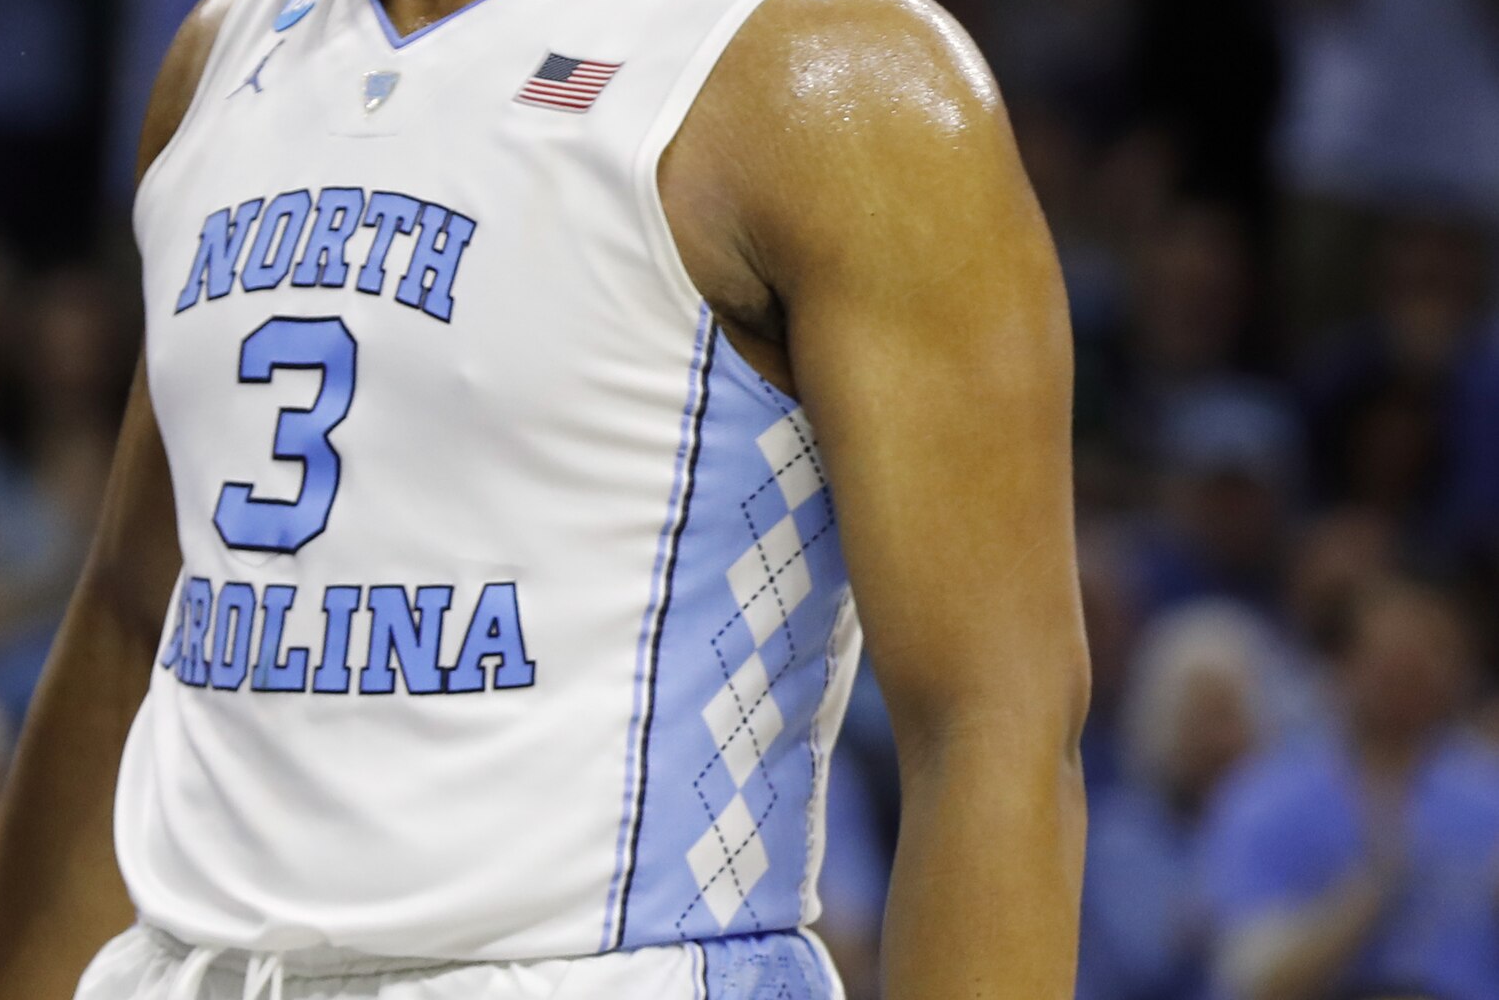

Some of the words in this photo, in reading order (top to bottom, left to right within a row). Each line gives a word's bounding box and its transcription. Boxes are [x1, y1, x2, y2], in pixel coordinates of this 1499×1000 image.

[174, 186, 478, 323] NORTH
[212, 315, 358, 555] 3
[160, 575, 536, 695] ROLINA
